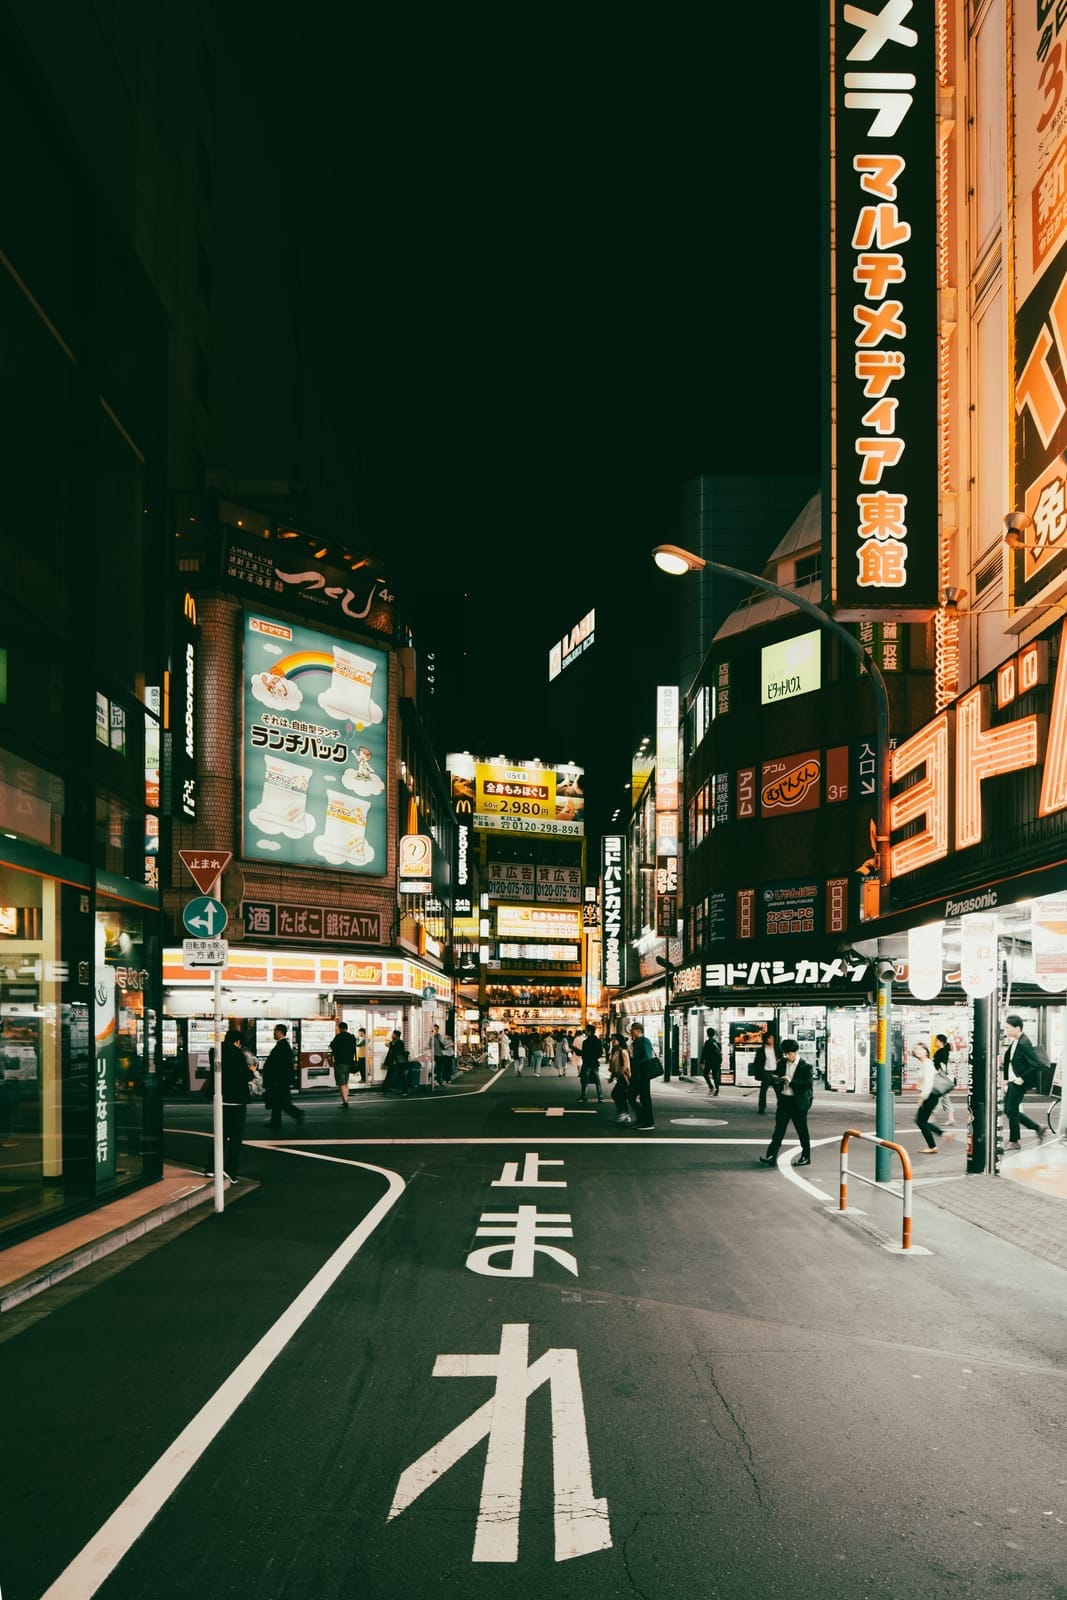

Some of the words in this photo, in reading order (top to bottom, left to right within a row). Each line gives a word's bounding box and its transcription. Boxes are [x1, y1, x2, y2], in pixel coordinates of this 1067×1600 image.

[851, 154, 911, 587] マルチメディア東館
[378, 588, 395, 603] 4F
[262, 714, 340, 739] それは、自由型ランチ
[251, 725, 348, 763] ランチパック
[859, 743, 876, 775] 入口
[762, 763, 786, 775] アコム
[486, 783, 547, 798] 全身もみほぐし
[766, 766, 816, 800] むじんくん
[717, 772, 728, 823] 新規受付中
[739, 771, 753, 816] アコム
[828, 785, 847, 800] 3F
[512, 821, 579, 834] 0120-298-894
[190, 859, 220, 869] 止まれ
[491, 865, 533, 880] 貸広告
[539, 868, 579, 883] 貸広告
[488, 881, 534, 896] 0120-075-787
[536, 884, 579, 899] 0120-075-787
[604, 837, 621, 937] ヨドバシカメラ
[945, 889, 998, 917] Panasonic
[248, 906, 271, 932] 酒
[280, 910, 320, 935] たばこ
[326, 913, 378, 937] 銀行ATM
[185, 942, 225, 950] 自転車を除く
[186, 951, 225, 960] 一方通行
[385, 1152, 613, 1563] 止まれ
